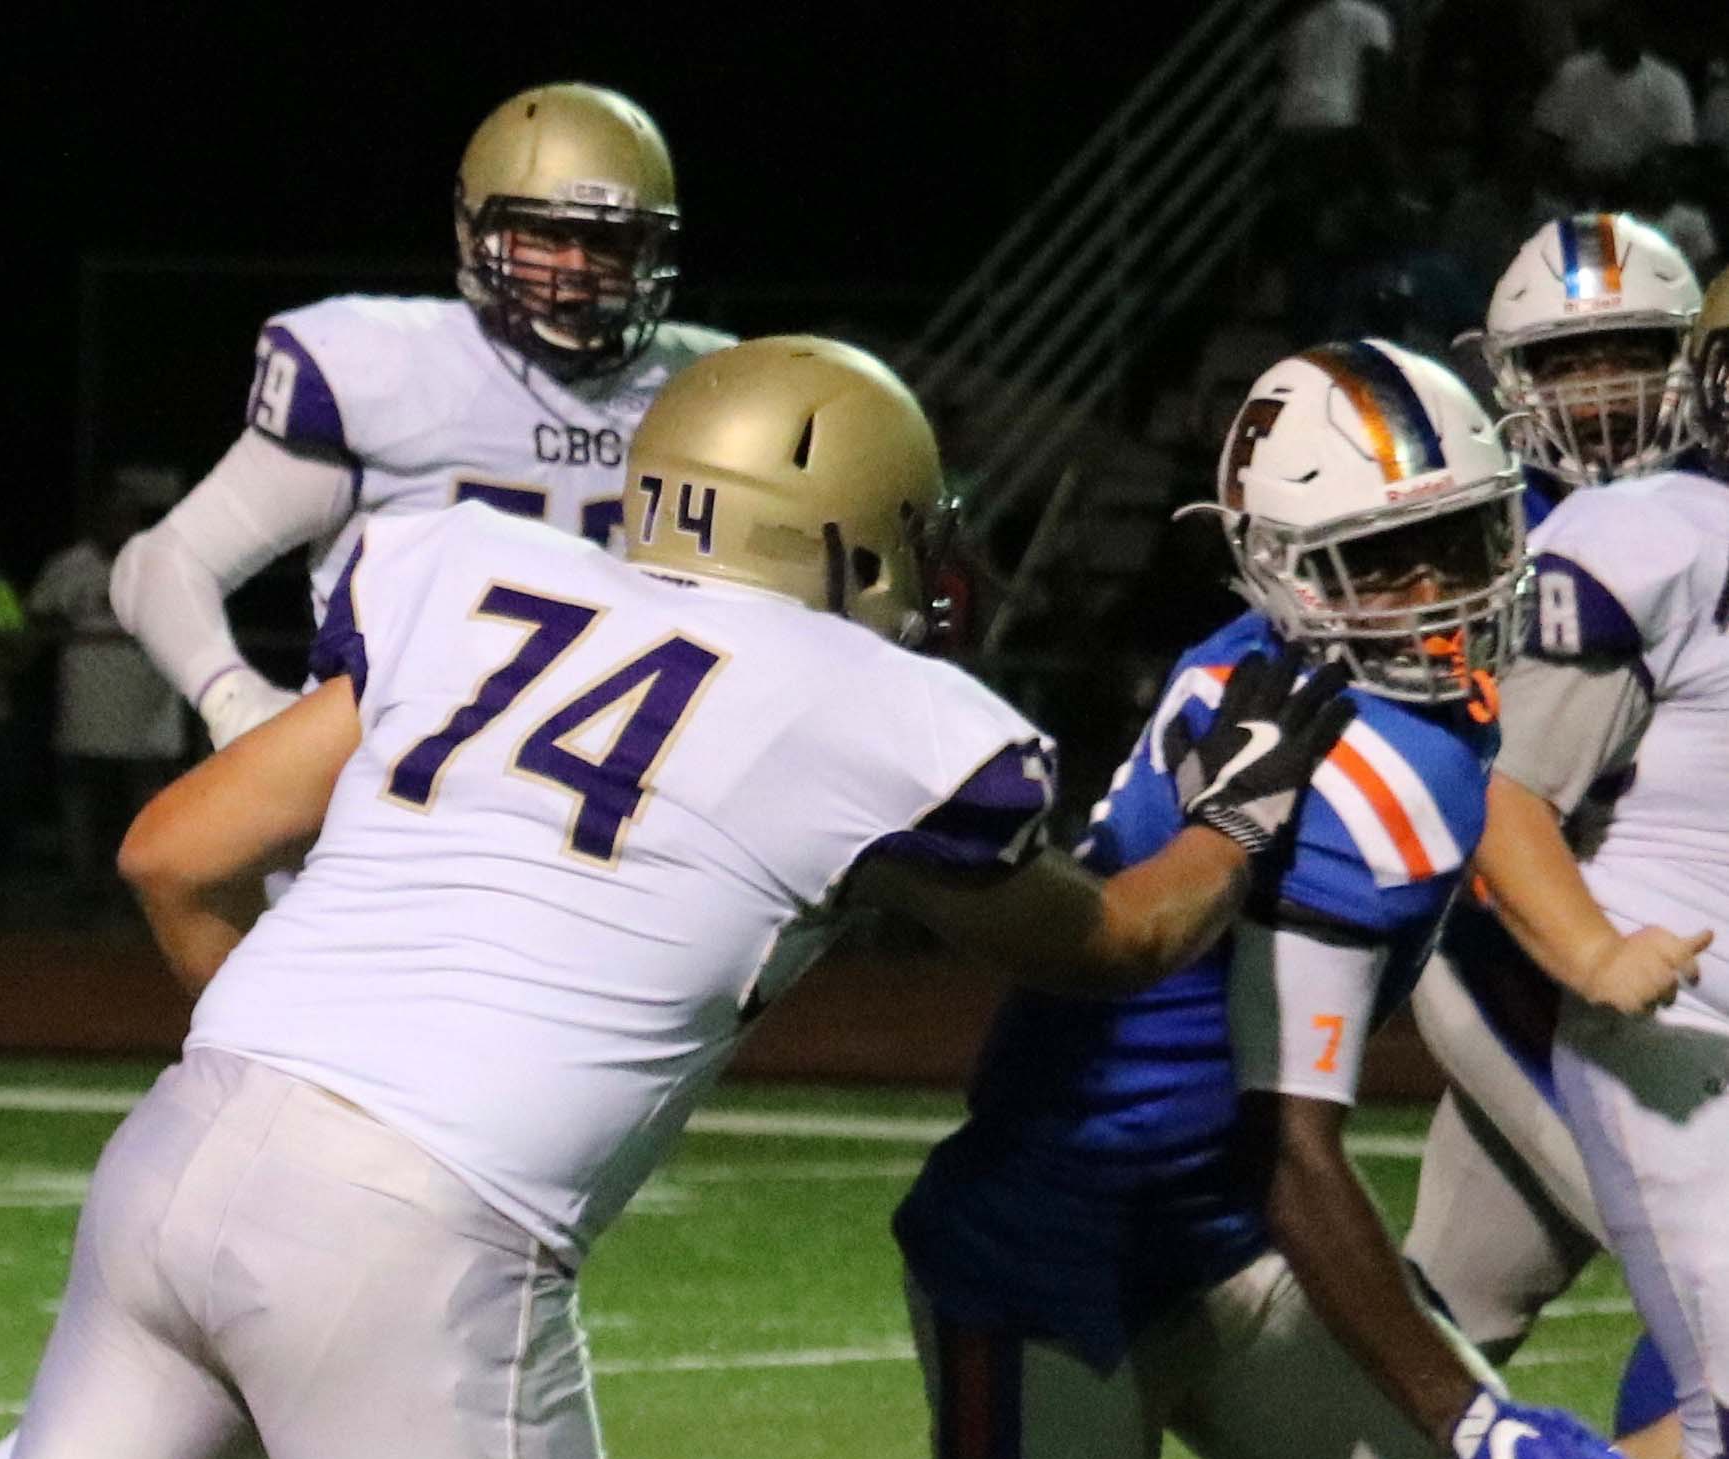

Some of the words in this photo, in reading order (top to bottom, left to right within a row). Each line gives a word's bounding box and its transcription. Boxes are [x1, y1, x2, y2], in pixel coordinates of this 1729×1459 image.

[533, 422, 622, 468] CBC
[638, 474, 718, 557] 74
[374, 577, 732, 871] 74
[1310, 1013, 1344, 1074] 7
